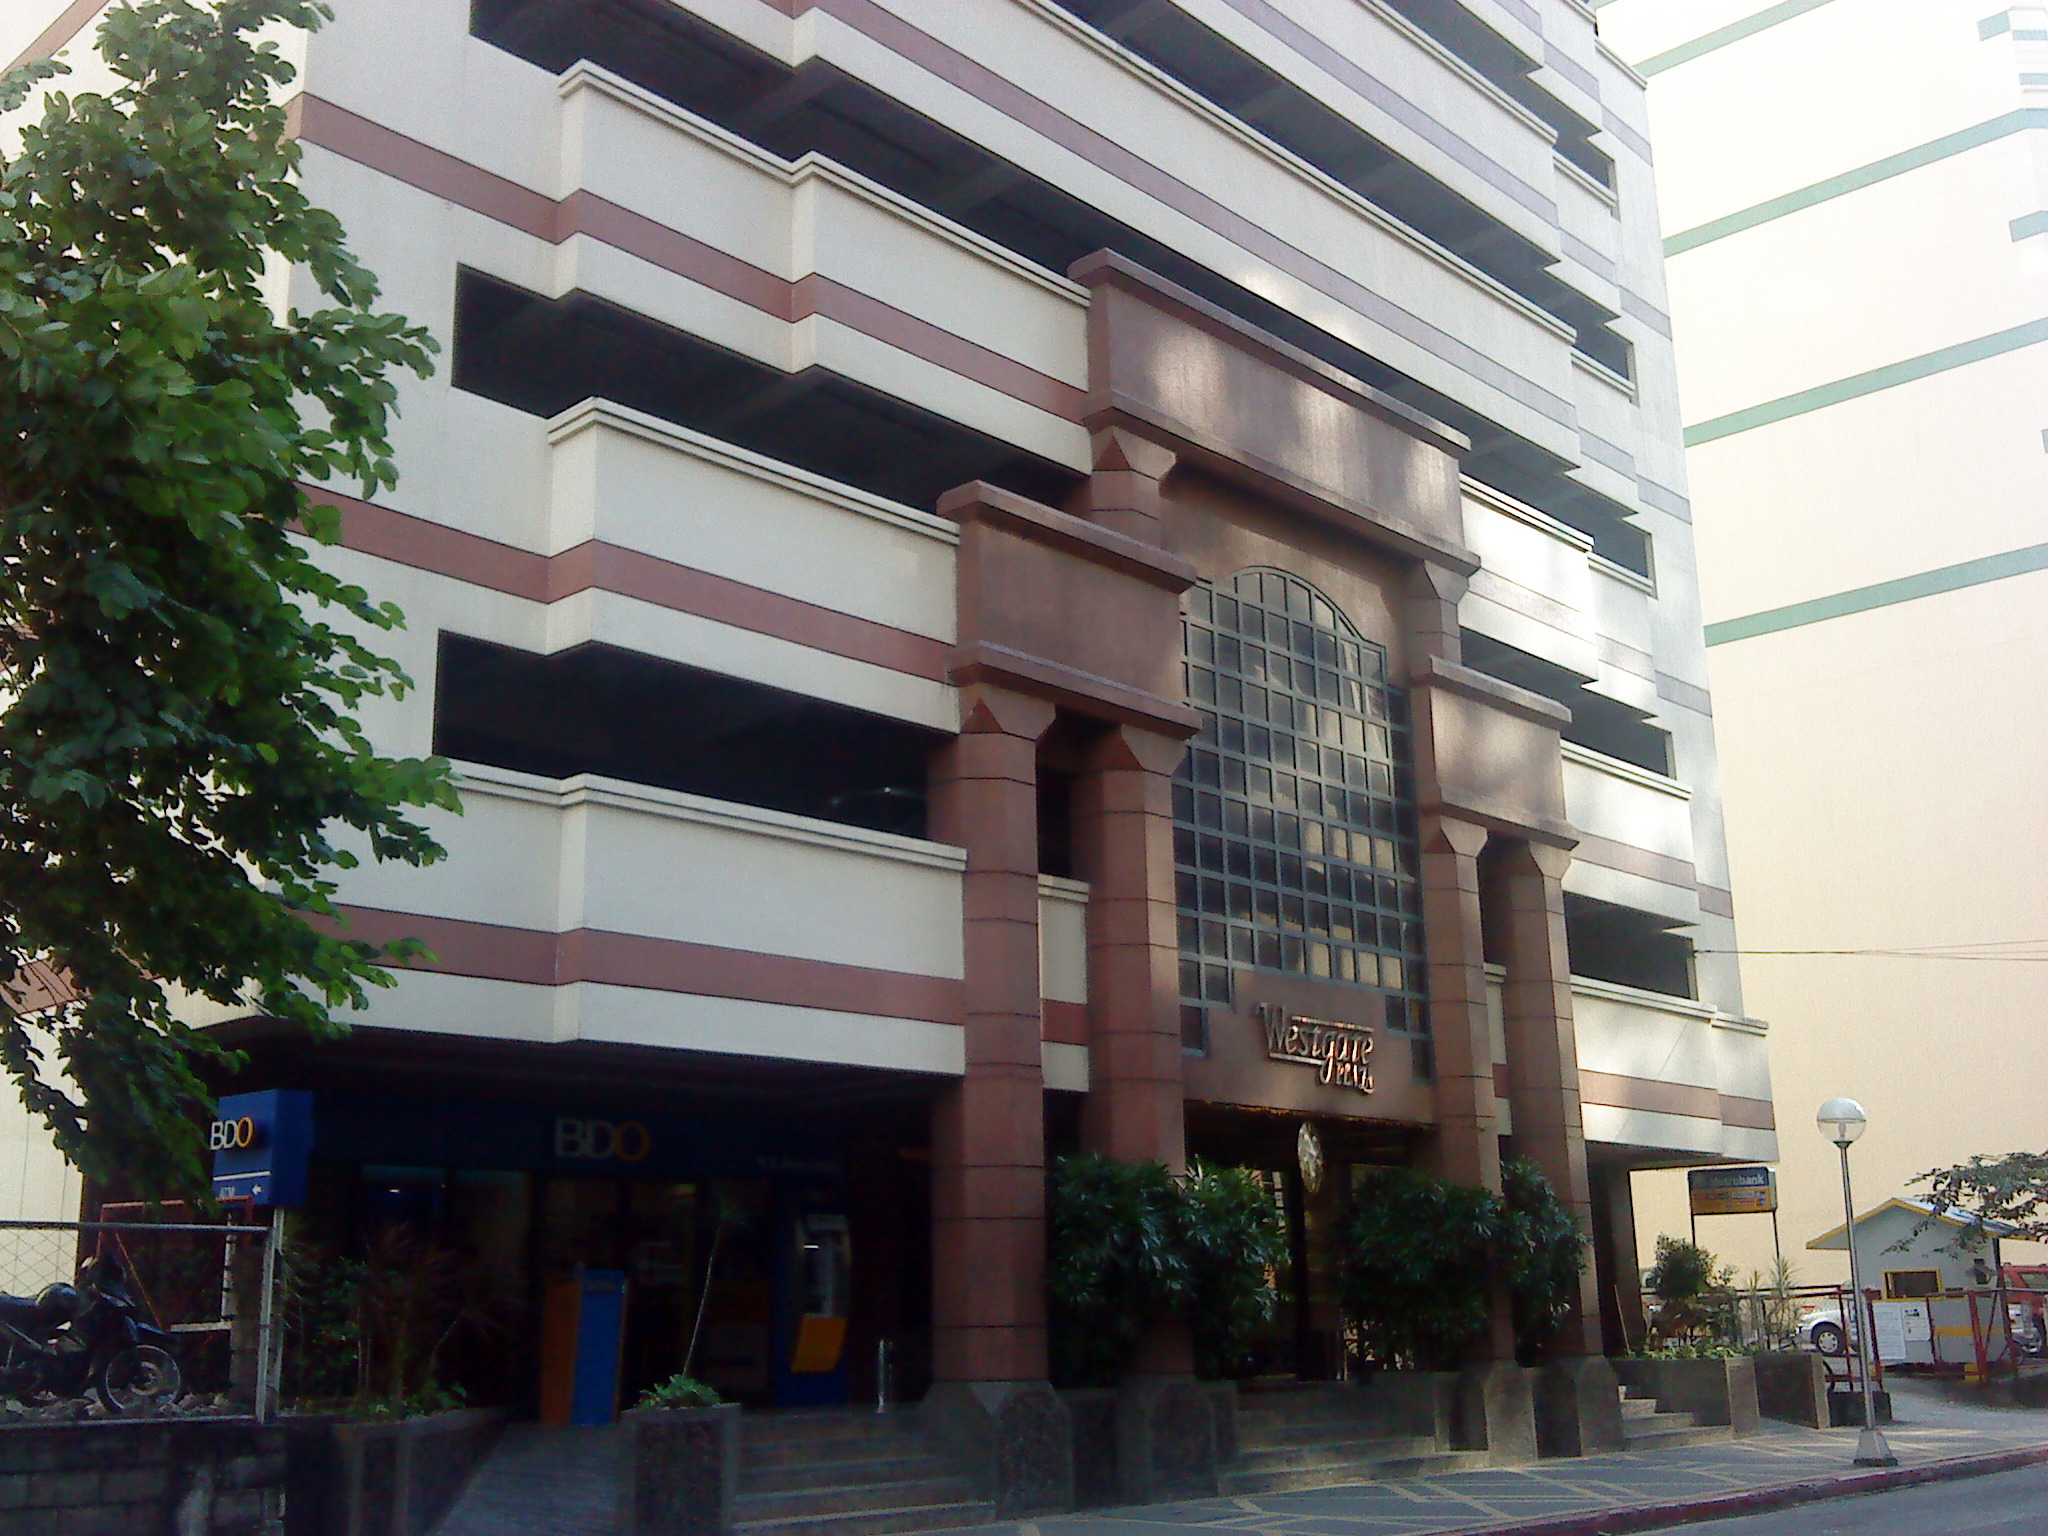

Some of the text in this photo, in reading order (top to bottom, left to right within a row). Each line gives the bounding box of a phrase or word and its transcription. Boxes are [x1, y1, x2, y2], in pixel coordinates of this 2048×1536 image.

[1256, 1002, 1374, 1084] Westgate
[211, 1116, 253, 1150] BDO
[555, 1117, 651, 1161] BDO
[217, 1186, 235, 1200] ATM
